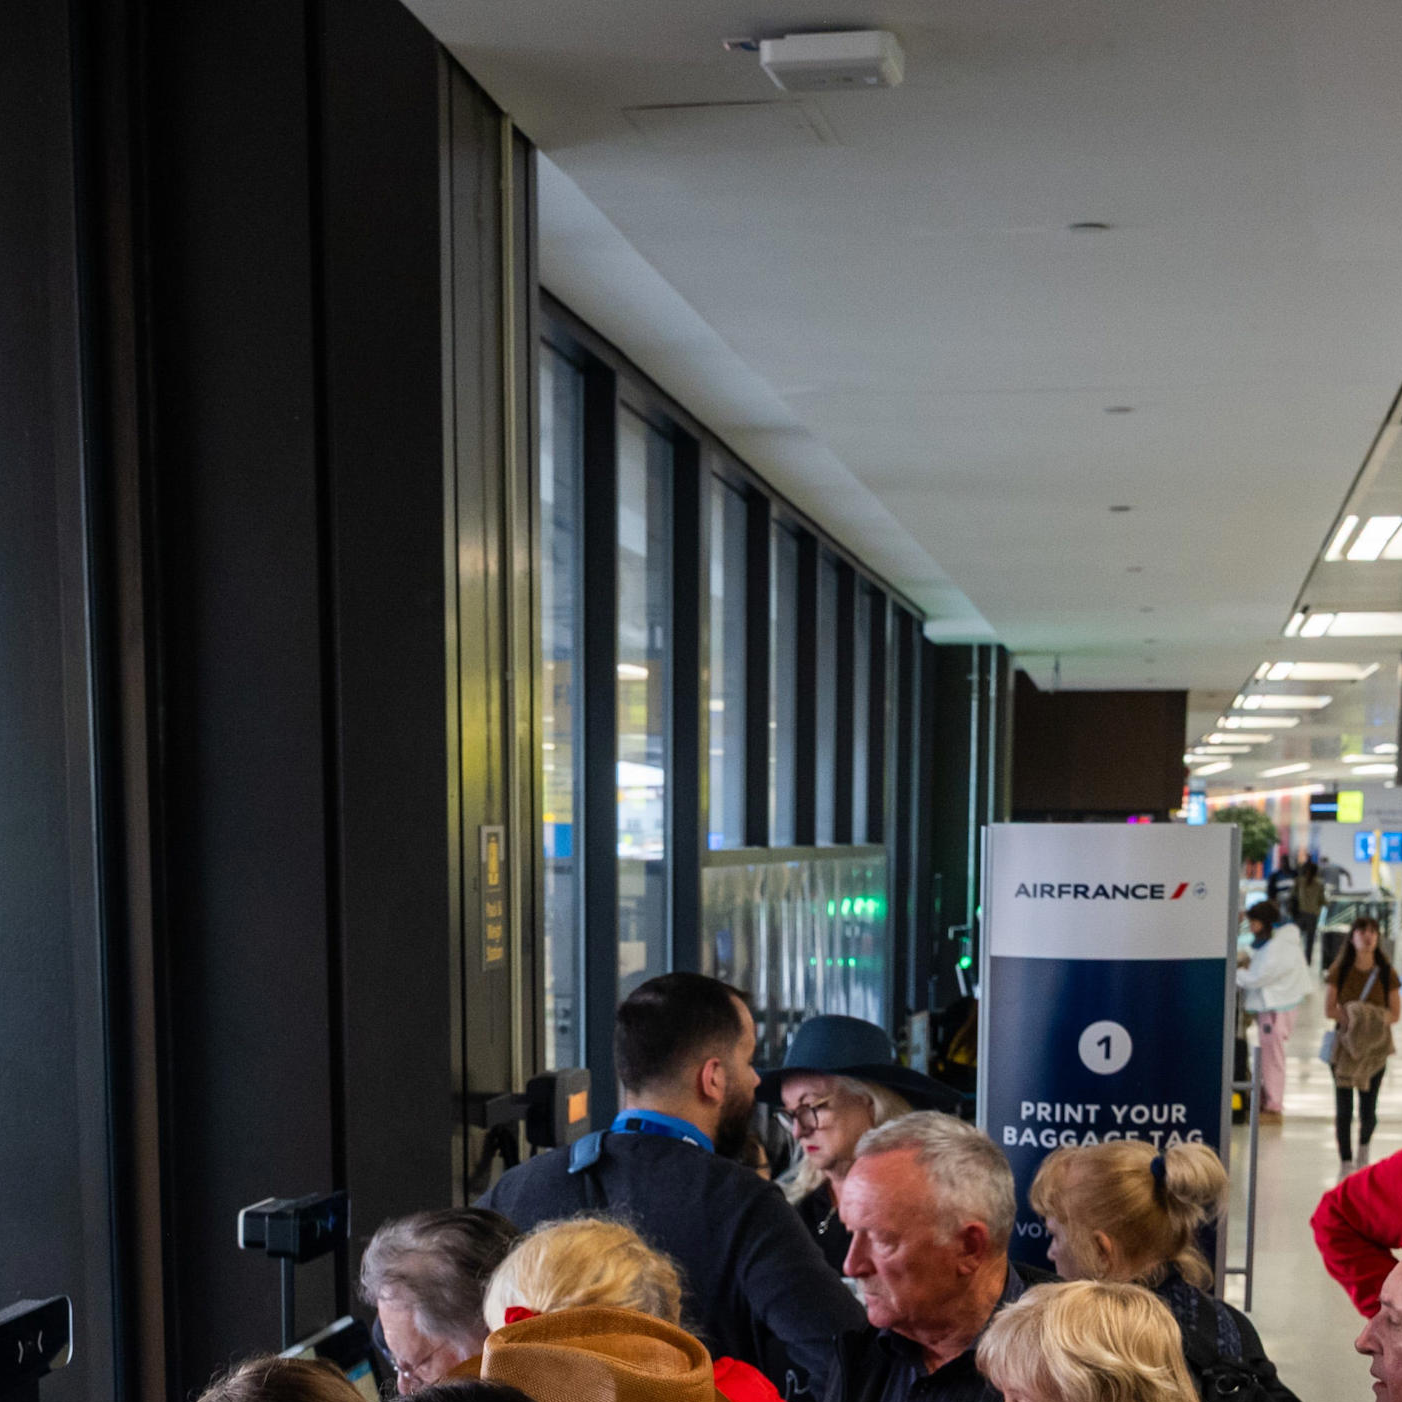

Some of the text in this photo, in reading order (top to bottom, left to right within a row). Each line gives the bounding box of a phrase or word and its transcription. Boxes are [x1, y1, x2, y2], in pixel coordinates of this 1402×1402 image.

[1014, 883, 1165, 900] AIRFRANCE
[1096, 1035, 1112, 1061] 1
[1021, 1101, 1187, 1124] PRINT YOUR
[1149, 1129, 1204, 1150] TAG
